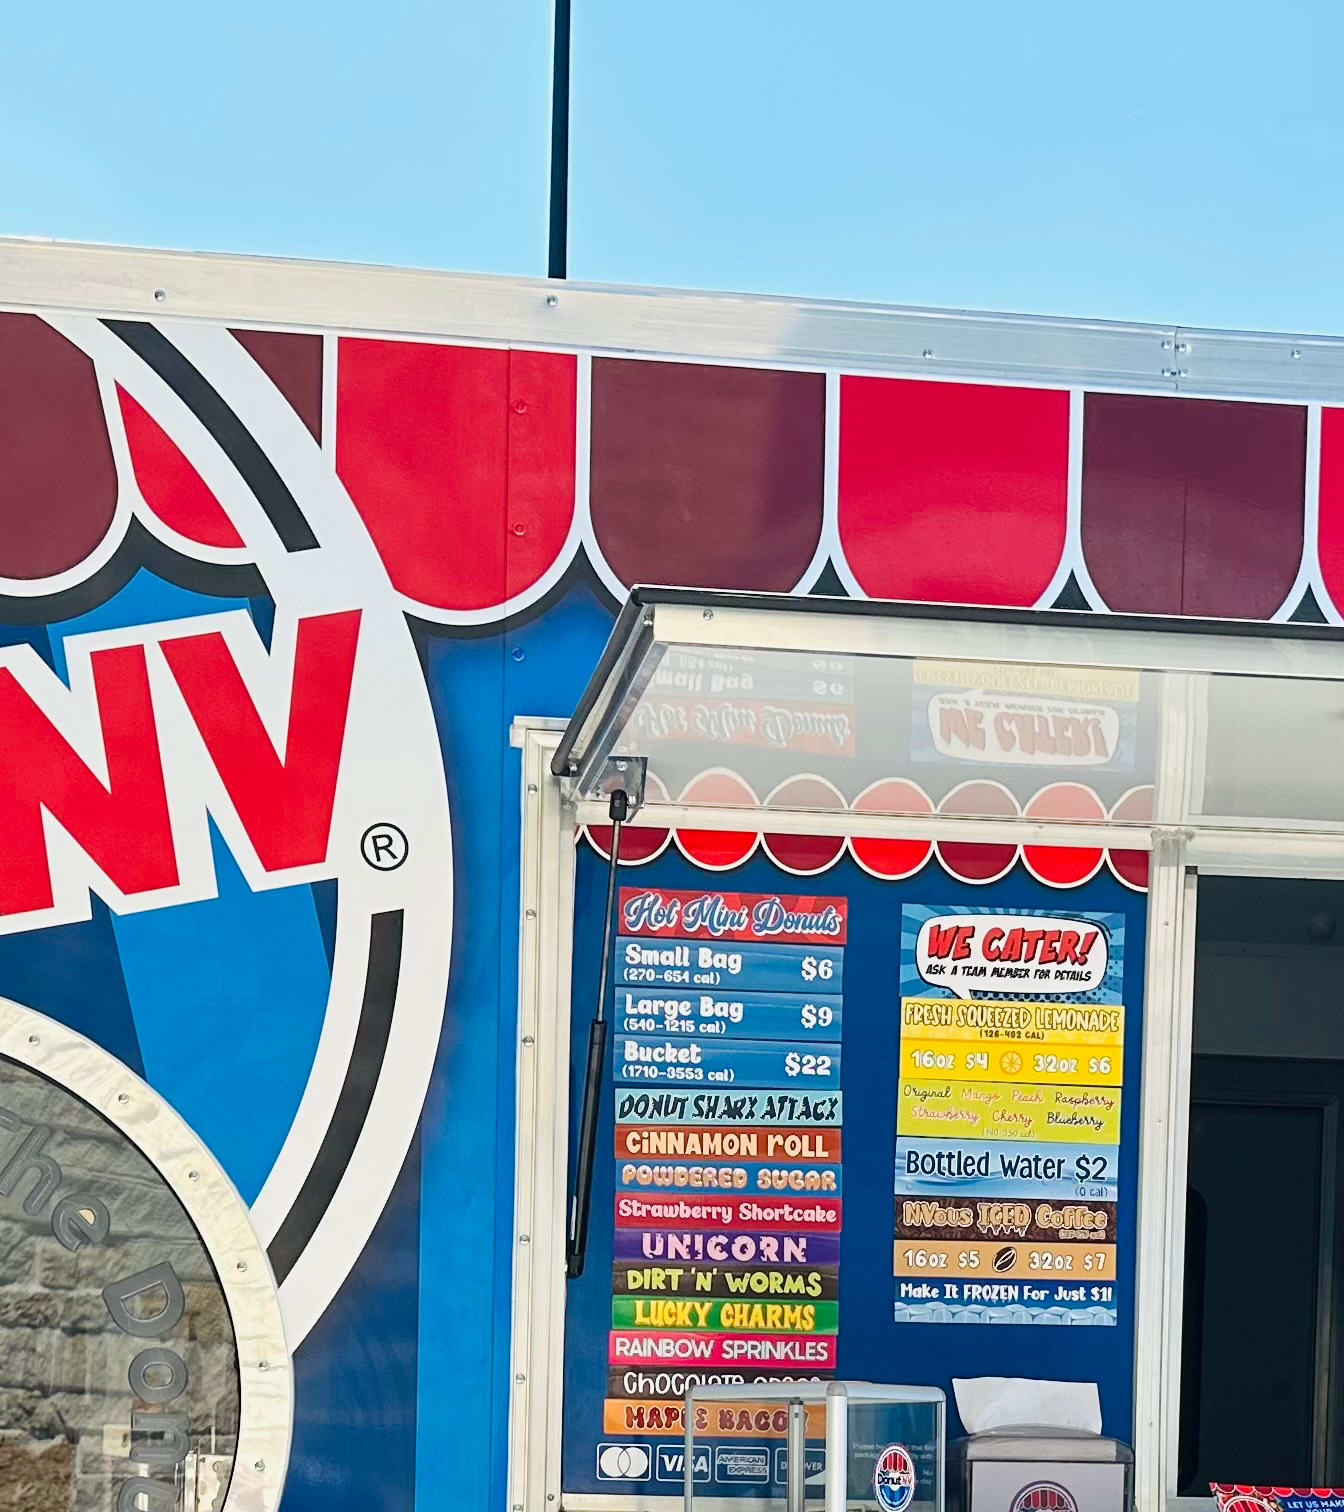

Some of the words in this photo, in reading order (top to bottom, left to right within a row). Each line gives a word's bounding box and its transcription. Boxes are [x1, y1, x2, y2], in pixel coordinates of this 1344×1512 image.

[623, 891, 680, 931] Hot
[682, 895, 748, 936] Mini
[752, 896, 843, 936] Donuts
[927, 924, 975, 961] WE
[982, 927, 1099, 966] CATER!
[625, 943, 690, 967] Small
[698, 947, 742, 974] Bag
[801, 956, 833, 981] $6
[925, 964, 946, 976] ASK
[951, 965, 958, 976] A
[961, 966, 987, 977] TEAM
[991, 967, 1031, 980] MEMBER
[1034, 968, 1051, 980] FOR
[1054, 970, 1092, 982] DETAILS
[693, 970, 720, 985] cal)
[625, 993, 692, 1020] Large
[699, 996, 744, 1023] Bag
[801, 1004, 833, 1029] $9
[905, 1003, 953, 1026] FRESH
[956, 1005, 1032, 1029] SQUEEZED
[1035, 1007, 1120, 1032] LEMONADE
[699, 1020, 726, 1034] cal)
[624, 1040, 702, 1064] Bucket
[784, 1051, 831, 1077] $22
[965, 1052, 990, 1070] $4
[1088, 1056, 1112, 1074] $6
[707, 1067, 734, 1082] cal)
[619, 1093, 689, 1120] DONUT
[691, 1094, 758, 1120] SHARK
[759, 1095, 839, 1121] ATTACK
[903, 1084, 952, 1103] Original
[1055, 1091, 1116, 1112] Raspberry
[911, 1105, 980, 1125] Strawberry
[992, 1109, 1033, 1129] Cherry
[1047, 1111, 1105, 1131] Blueberry
[621, 1164, 747, 1189] POWDERED
[757, 1167, 837, 1191] SUGAR
[906, 1150, 990, 1178] Bottled
[1075, 1154, 1108, 1184] $2
[618, 1199, 733, 1224] Strawberry
[739, 1202, 837, 1223] Shortcake
[903, 1201, 973, 1228] NVous
[977, 1202, 1032, 1233] ICED
[1035, 1204, 1108, 1230] Coffee
[642, 1232, 807, 1263] UNICORN
[903, 1249, 948, 1268] 16oz
[958, 1250, 980, 1269] $5
[1029, 1251, 1073, 1271] 32oz
[1084, 1252, 1106, 1271] $7
[627, 1267, 683, 1292] DIRT
[690, 1268, 718, 1292] 'N'
[725, 1271, 822, 1297] WORMS
[900, 1283, 940, 1299] Make
[943, 1283, 959, 1299] It
[963, 1284, 1019, 1302] FROZEN
[1023, 1285, 1049, 1302] For
[1054, 1285, 1086, 1302] Just
[634, 1300, 716, 1327] LUCKY
[720, 1302, 817, 1331] CHARMS
[615, 1337, 714, 1359] RAINBOW
[721, 1340, 829, 1362] SPRINKLES
[718, 1408, 809, 1433] BACO
[718, 1455, 765, 1464] AMERICAN
[728, 1465, 767, 1475] EXPRESS
[1287, 1501, 1304, 1509] LET
